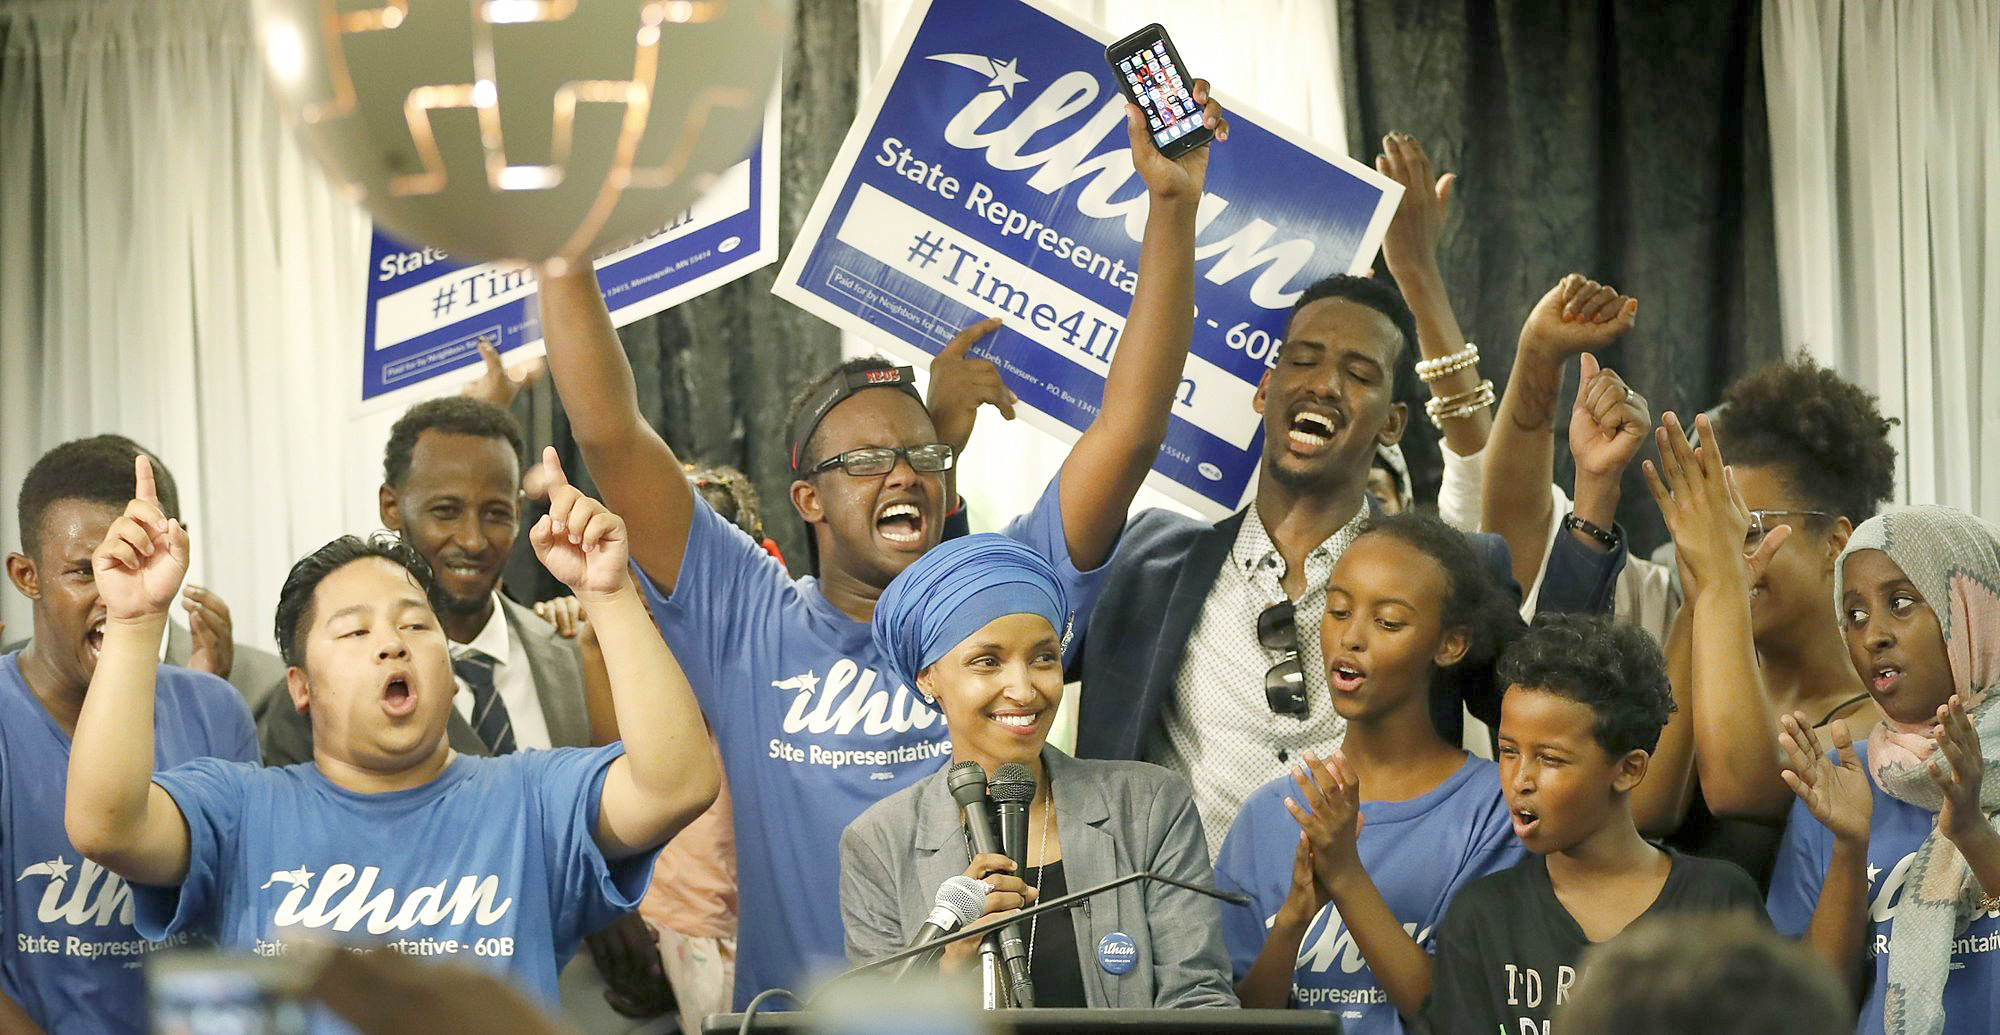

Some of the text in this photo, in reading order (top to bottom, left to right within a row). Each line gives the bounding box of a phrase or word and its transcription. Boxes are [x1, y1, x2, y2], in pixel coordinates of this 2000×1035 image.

[875, 137, 961, 200] State
[964, 182, 1138, 296] Representa
[833, 272, 854, 289] Paid
[852, 282, 868, 296] for
[865, 289, 879, 303] by
[876, 295, 922, 326] Neighbors
[920, 317, 935, 330] for
[1060, 390, 1076, 404] Box
[783, 658, 947, 736] ilha
[809, 740, 952, 769] Representative
[272, 863, 512, 935] ilhan
[474, 937, 514, 957] 60B
[1505, 964, 1542, 1008] I'D
